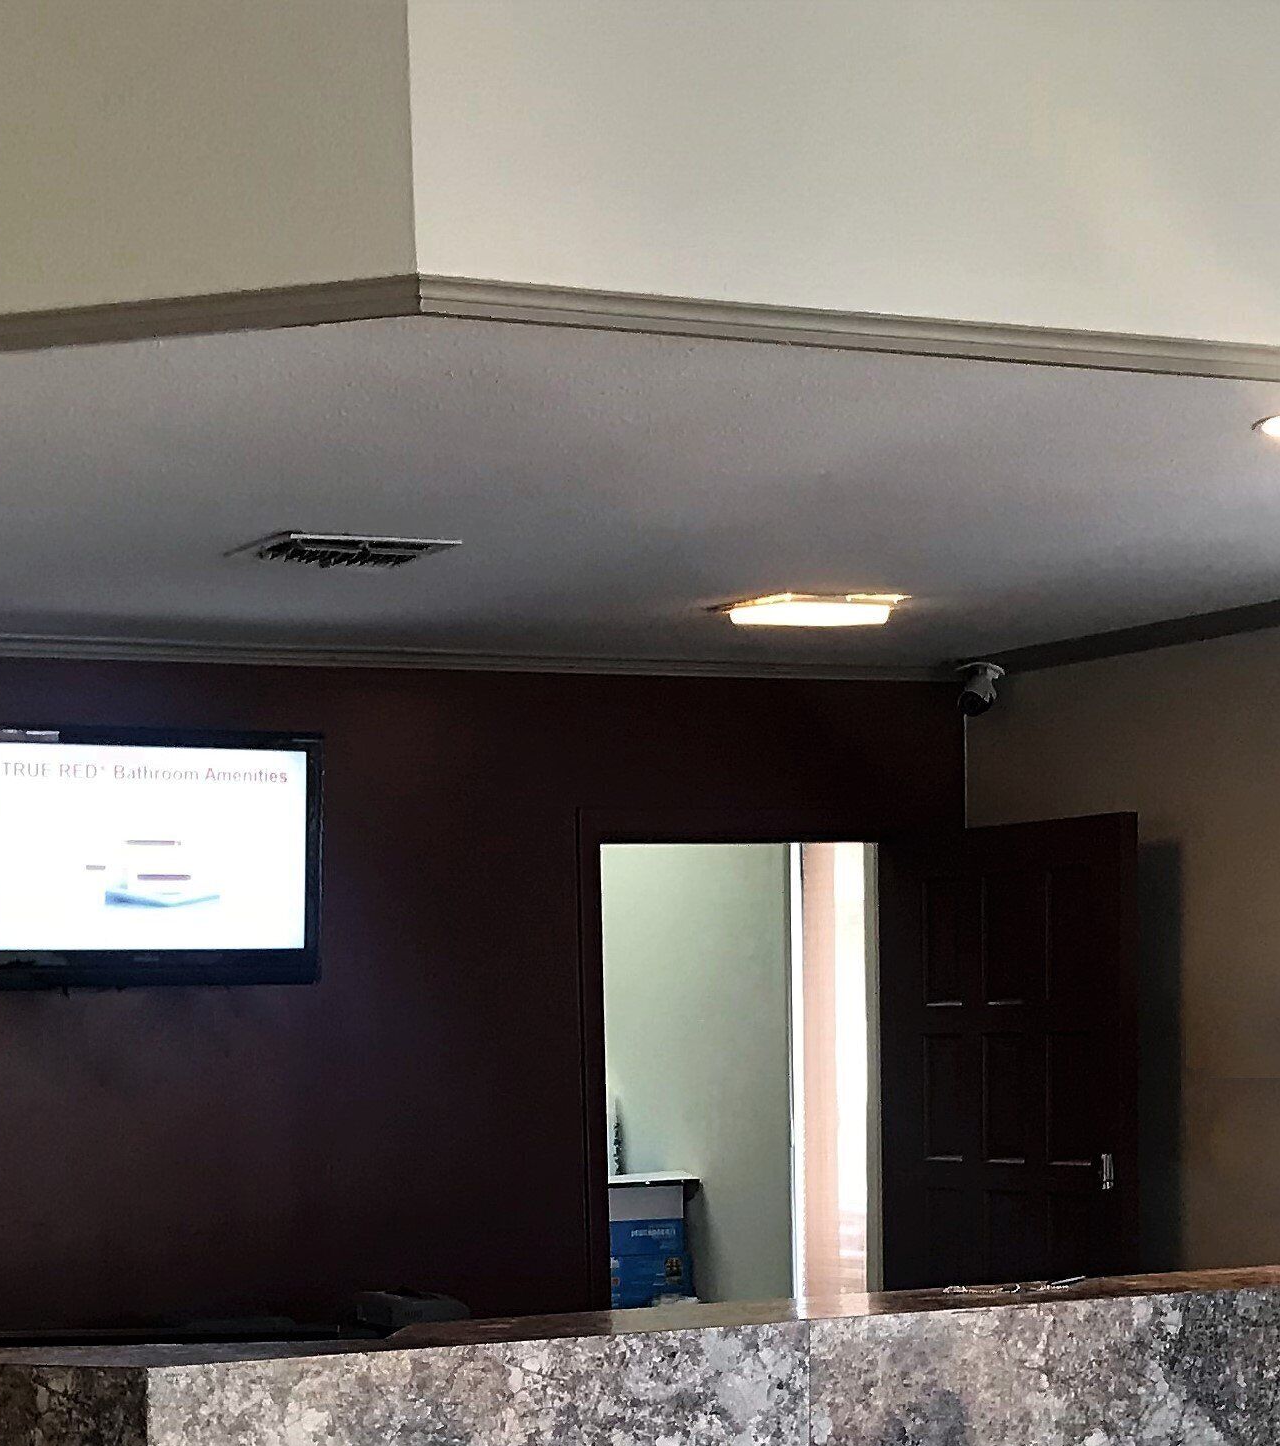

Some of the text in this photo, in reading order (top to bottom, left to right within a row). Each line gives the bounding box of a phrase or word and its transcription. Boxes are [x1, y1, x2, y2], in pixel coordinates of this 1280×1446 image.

[3, 762, 50, 778] TRUE
[113, 764, 200, 782] Bathroom
[205, 767, 288, 783] Amenities
